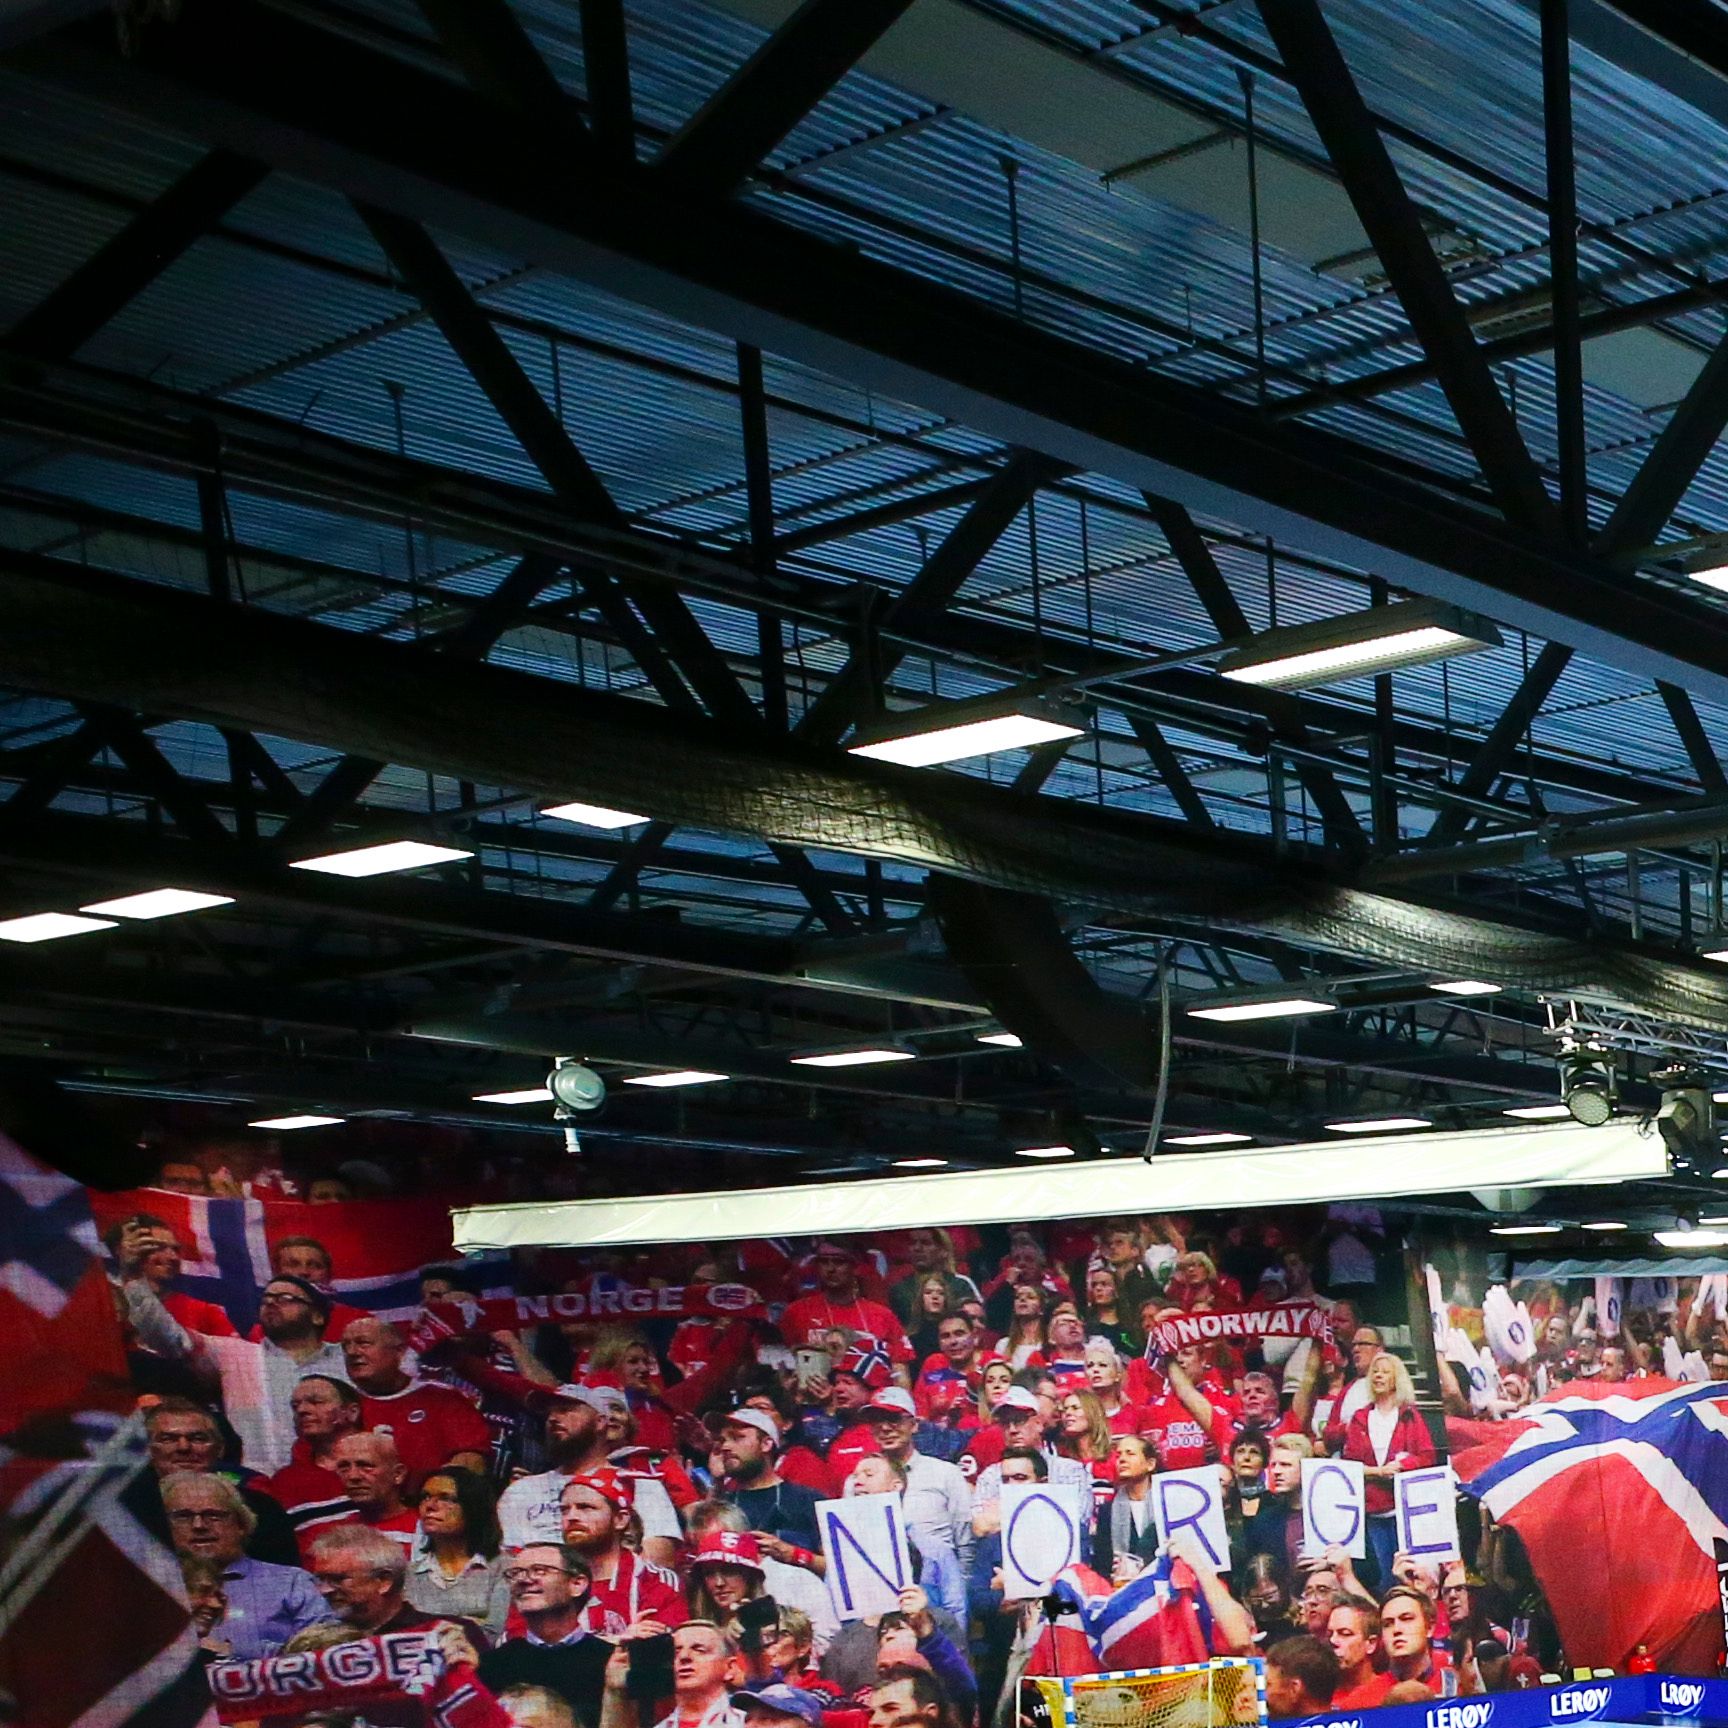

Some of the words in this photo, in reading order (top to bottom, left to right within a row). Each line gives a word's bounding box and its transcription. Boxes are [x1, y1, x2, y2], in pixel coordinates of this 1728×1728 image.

[517, 1286, 683, 1319] NORGE
[1177, 1308, 1310, 1344] NORWAY
[829, 1507, 903, 1607] N
[1008, 1493, 1074, 1587] O
[1163, 1477, 1216, 1565] R
[1308, 1465, 1360, 1546] G
[1406, 1485, 1450, 1553] E
[1551, 1689, 1610, 1717] LERØY
